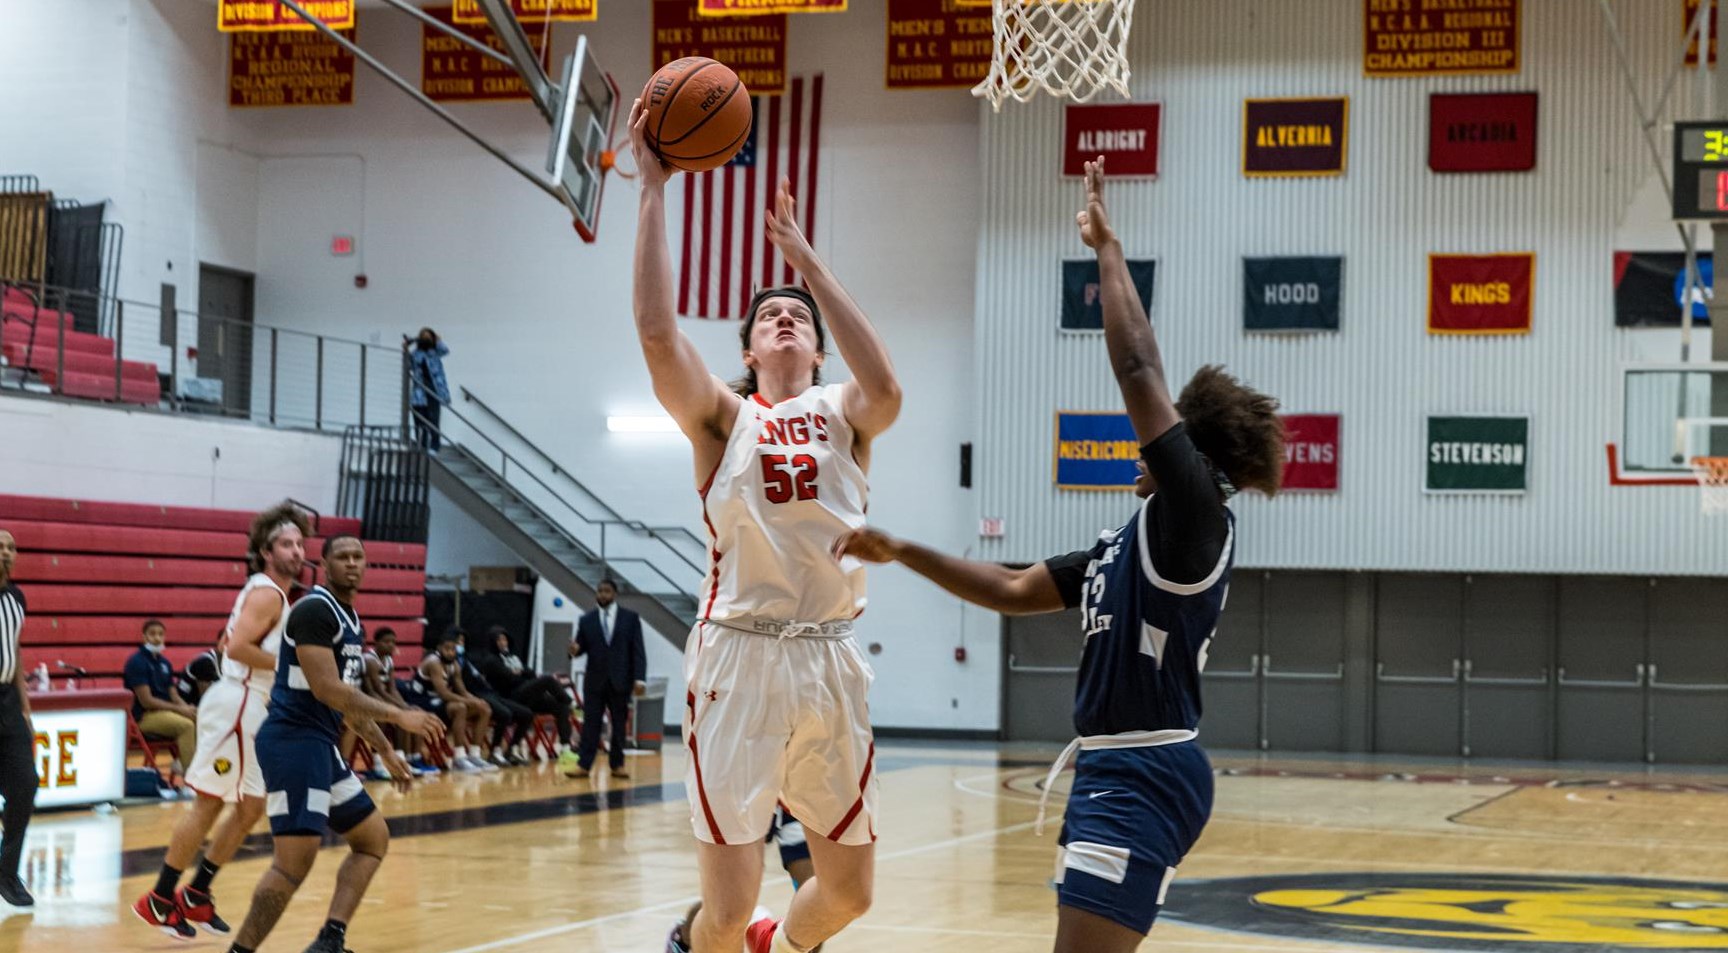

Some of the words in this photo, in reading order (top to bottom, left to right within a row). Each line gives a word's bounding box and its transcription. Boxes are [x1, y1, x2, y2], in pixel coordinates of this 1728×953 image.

[657, 27, 693, 43] MEN'S
[702, 26, 781, 42] BASKETBALL
[890, 19, 945, 36] MEN'S
[1377, 32, 1470, 50] DIVISION
[1482, 30, 1505, 47] III
[249, 60, 335, 74] REGIONAL
[1367, 50, 1513, 69] CHAMPIONSHIP
[232, 74, 350, 89] CHAMPIONSHIP
[890, 64, 943, 80] DIVISION
[426, 78, 475, 94] DIVISION
[701, 86, 726, 111] ROCK
[1077, 130, 1146, 151] ALBRIGHT
[1256, 125, 1332, 147] ALVERNIA
[1264, 283, 1319, 304] HOOD
[1059, 440, 1140, 459] MISERICORD
[1285, 442, 1334, 463] VENS
[1430, 442, 1524, 465] STEVENSON
[759, 454, 818, 504] 52
[33, 731, 78, 788] GE
